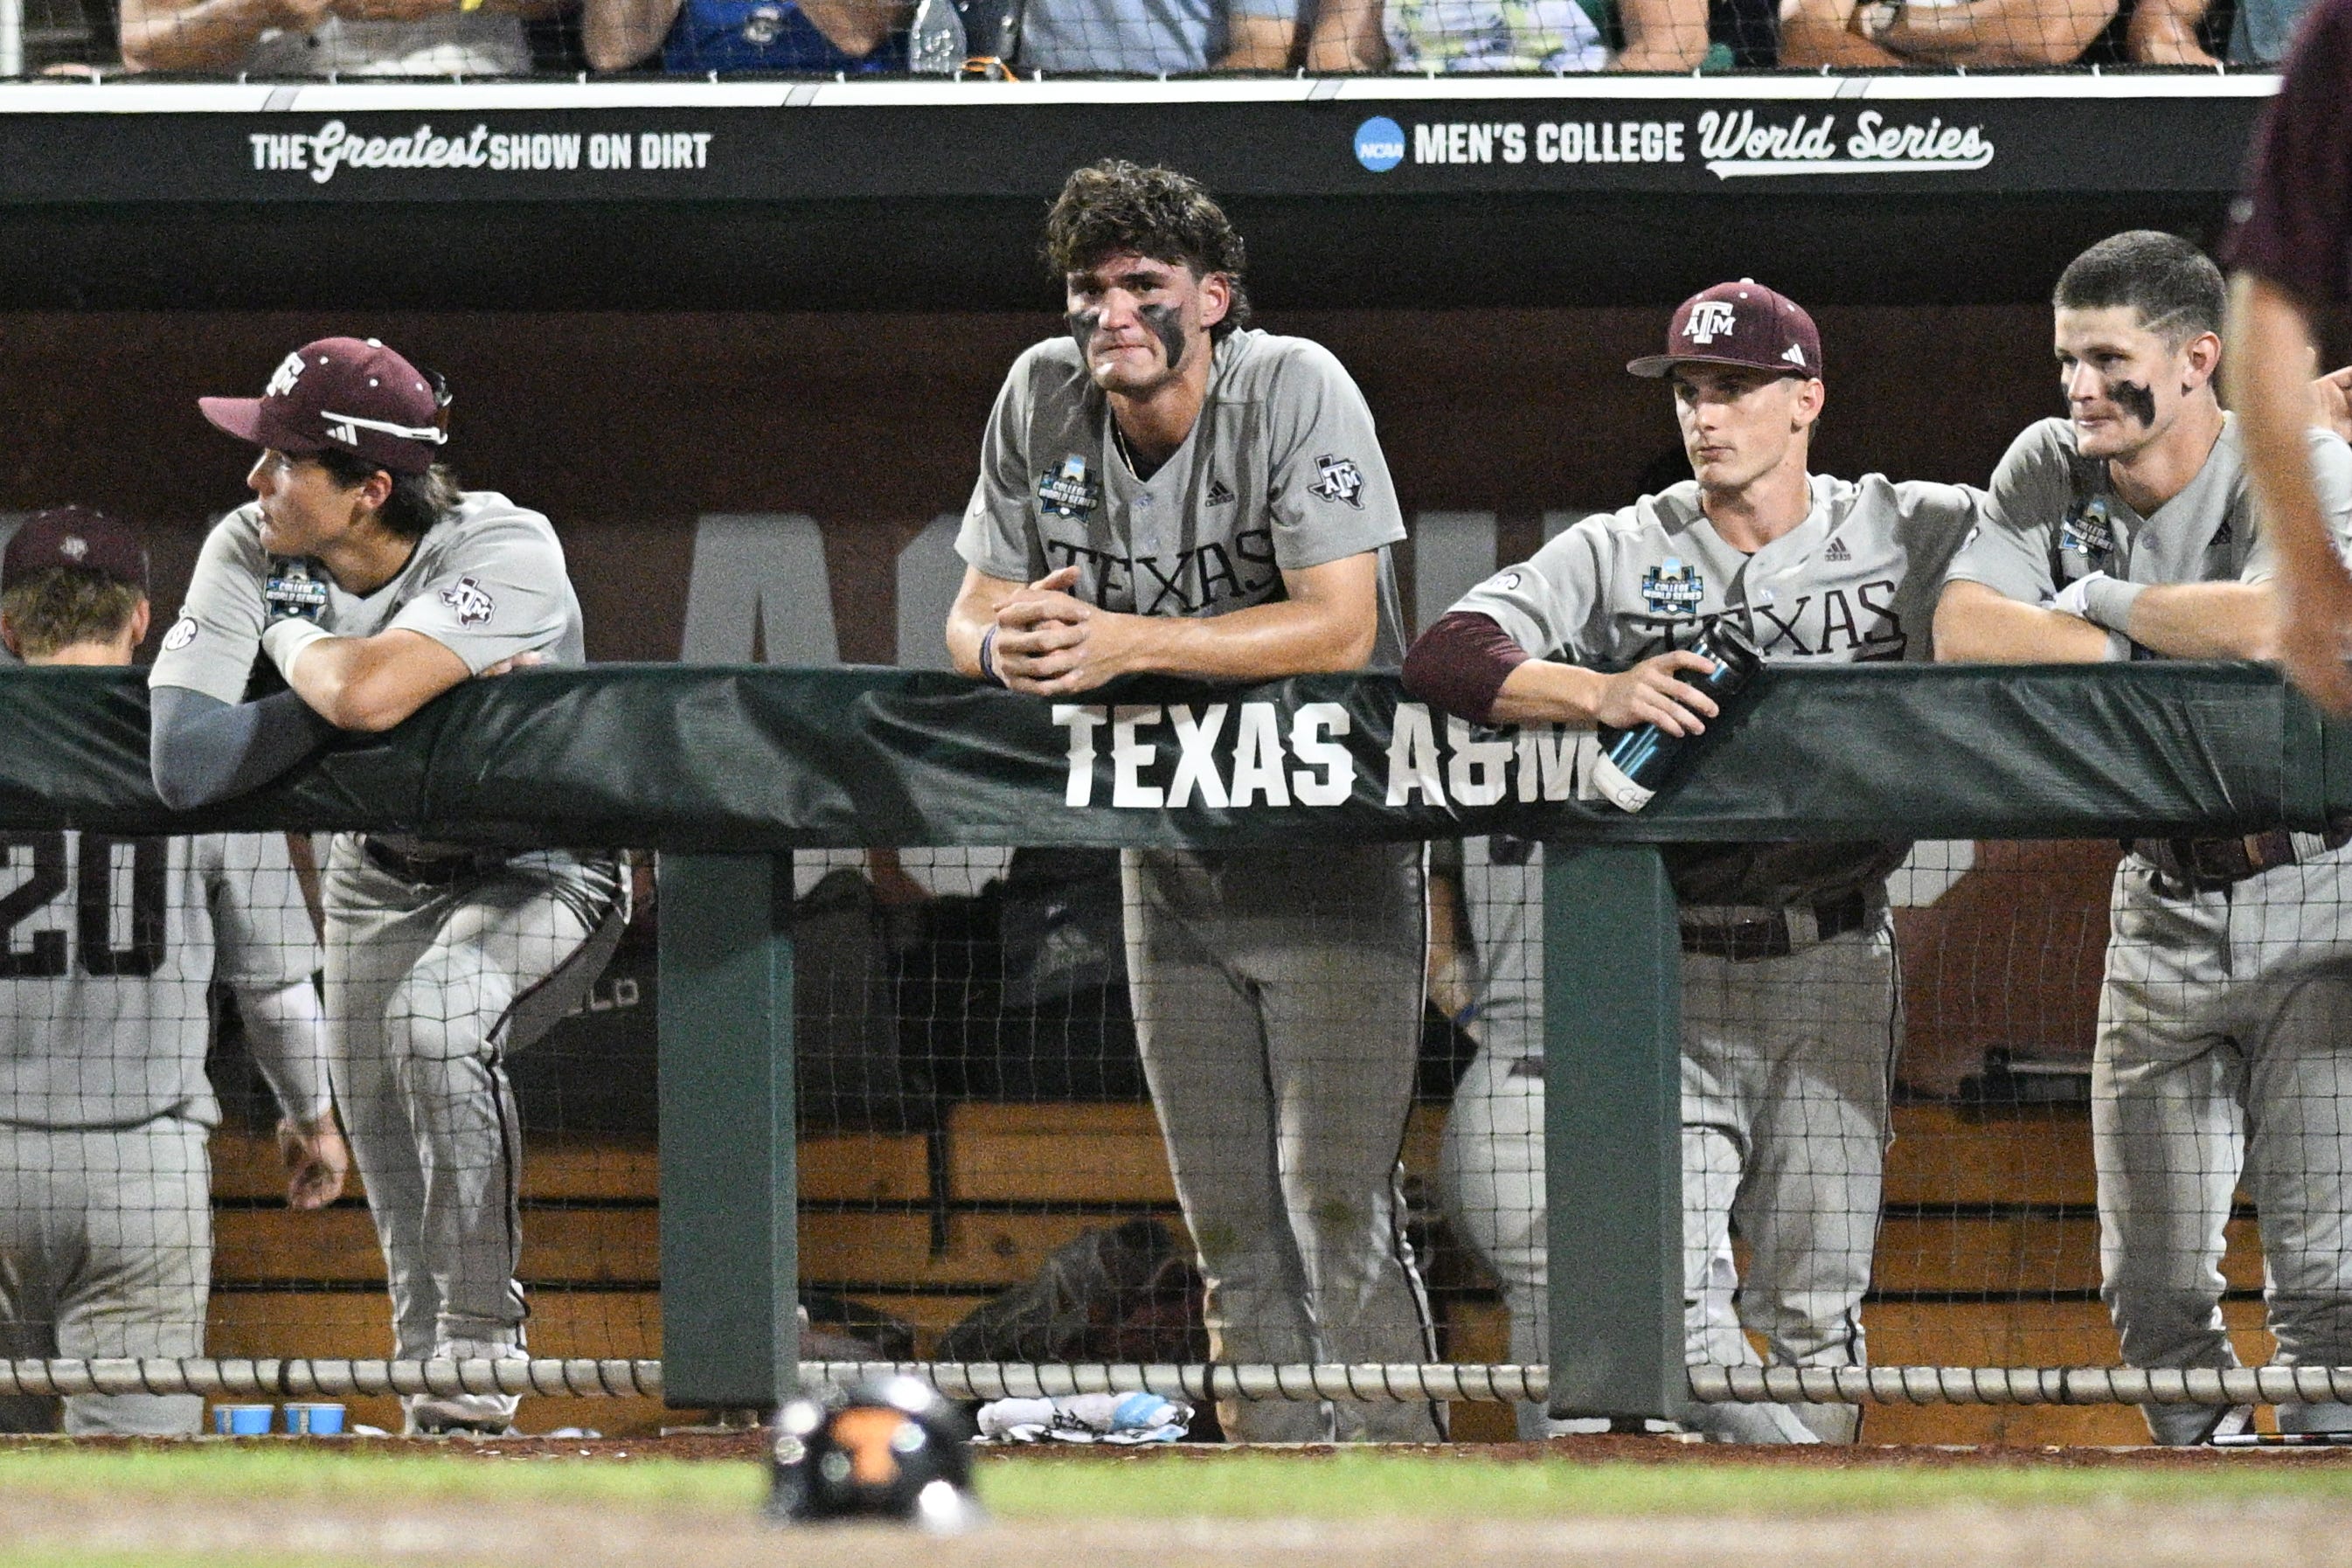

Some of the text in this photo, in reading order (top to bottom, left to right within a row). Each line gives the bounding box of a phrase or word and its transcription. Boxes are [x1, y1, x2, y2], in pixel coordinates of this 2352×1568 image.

[249, 119, 712, 184] THE Greatest SHOW ON DIRT
[1413, 109, 1995, 163] MEN'S COLLEGE World Series
[1645, 579, 1907, 656] TXAS
[1051, 702, 1603, 808] TEXAS A&M
[0, 829, 167, 976] 20
